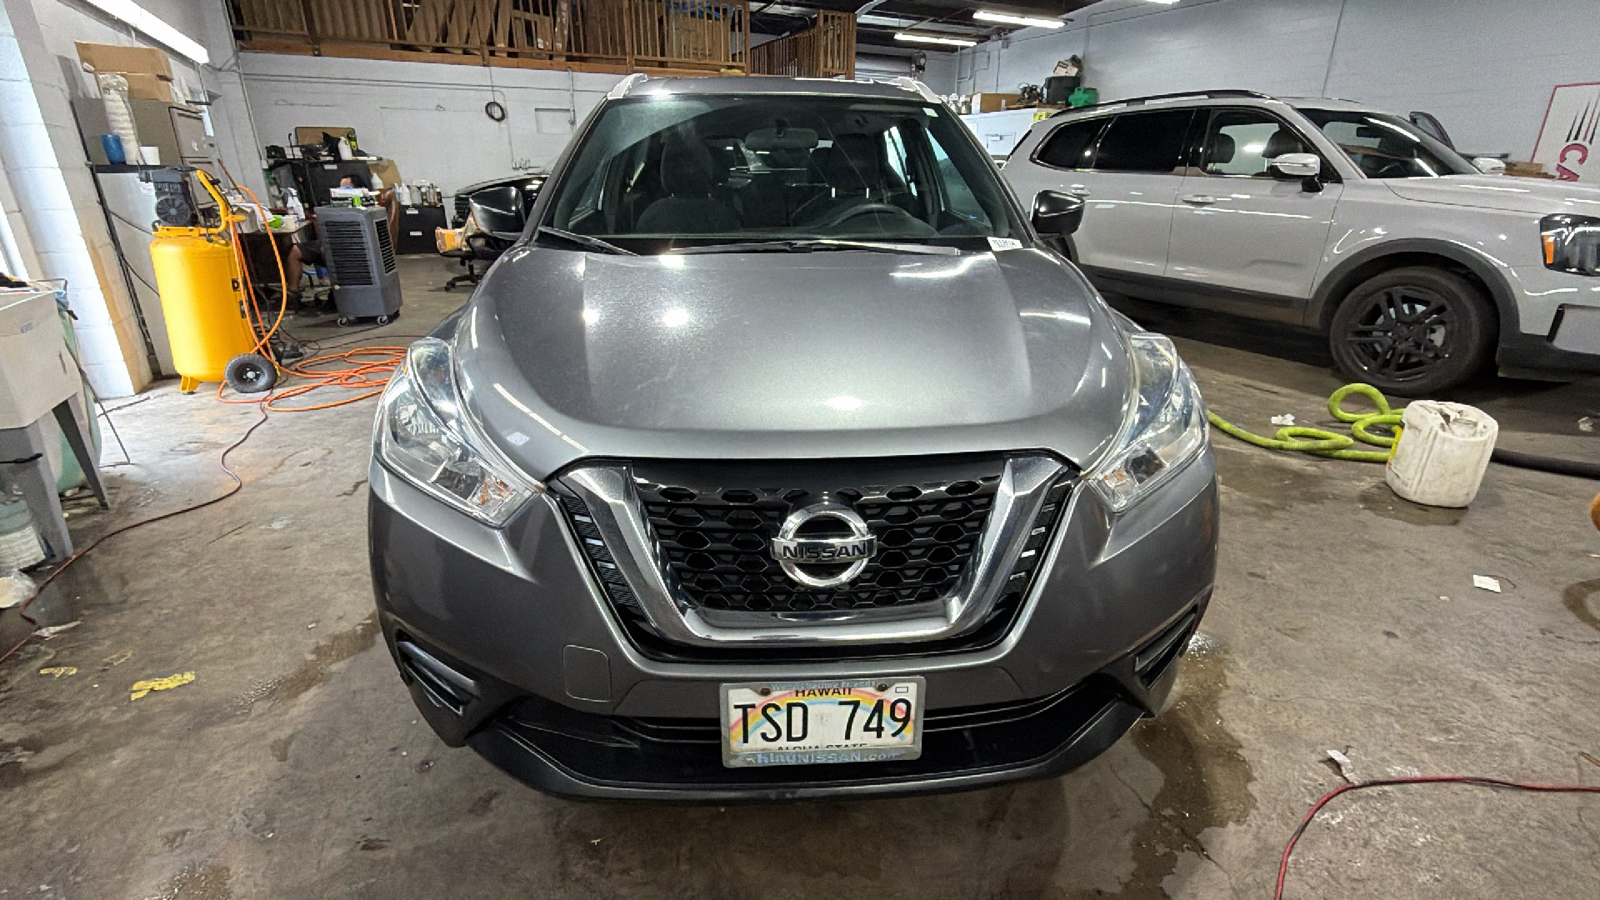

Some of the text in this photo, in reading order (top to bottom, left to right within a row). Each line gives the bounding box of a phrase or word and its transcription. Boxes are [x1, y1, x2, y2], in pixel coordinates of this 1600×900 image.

[782, 544, 867, 560] NISSAN
[733, 697, 912, 744] TSD 749
